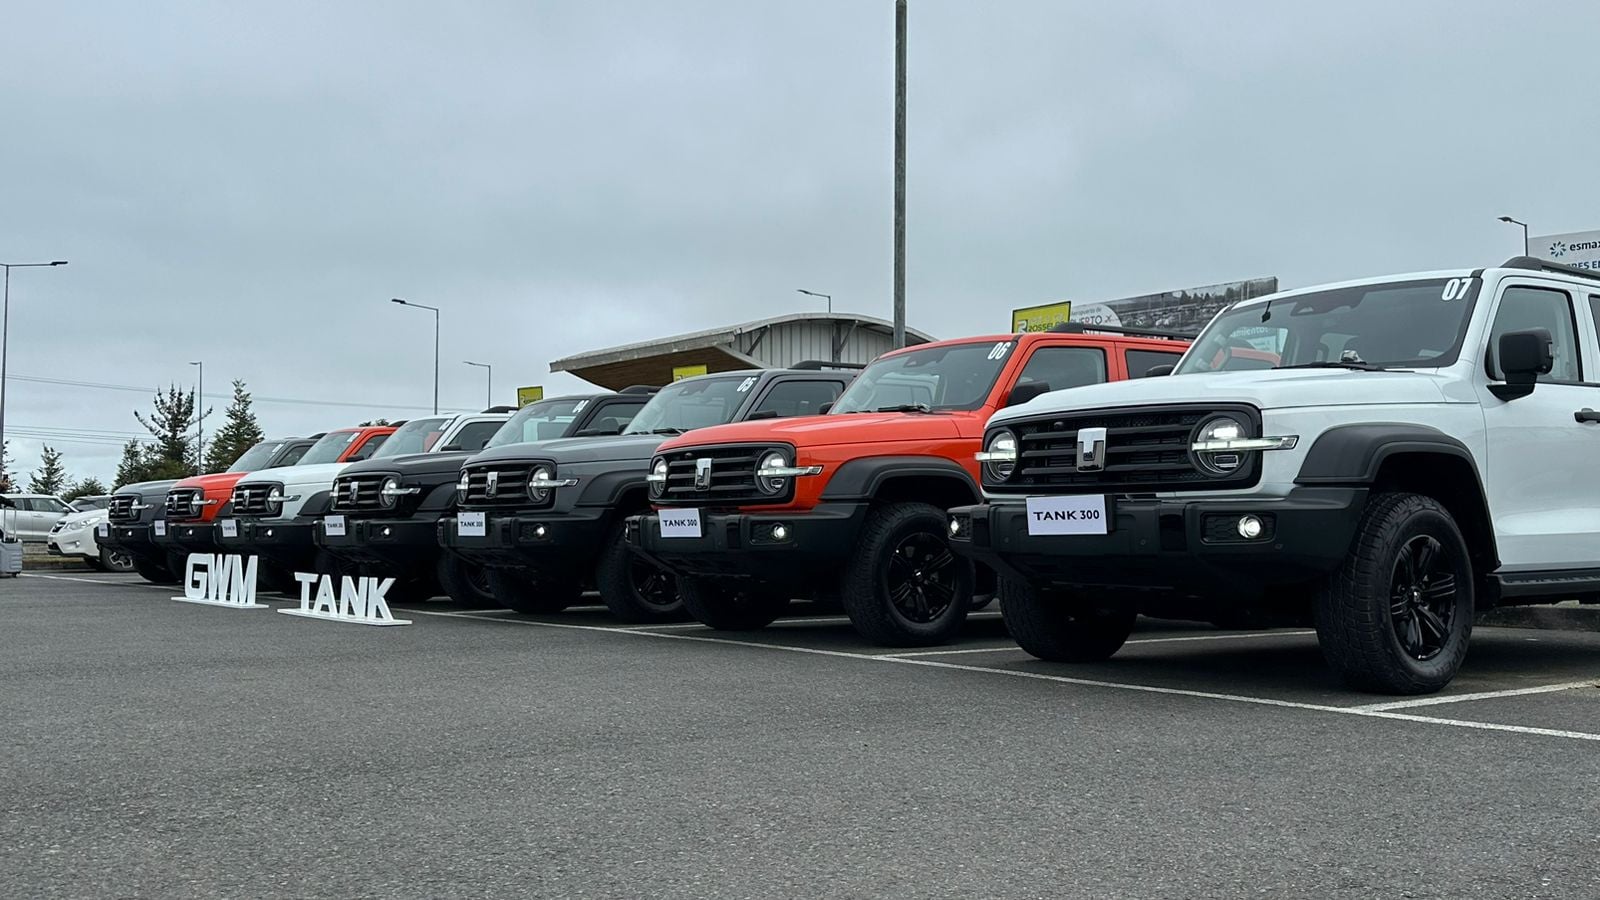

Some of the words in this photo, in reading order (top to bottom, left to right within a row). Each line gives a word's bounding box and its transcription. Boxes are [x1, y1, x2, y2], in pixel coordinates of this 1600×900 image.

[1567, 261, 1590, 270] RES
[1441, 277, 1474, 301] 07
[987, 341, 1012, 360] 06
[736, 376, 758, 392] 05
[662, 519, 686, 528] TANK
[686, 518, 698, 527] 300
[1033, 510, 1077, 521] TANK
[1079, 509, 1100, 520] 300
[184, 552, 258, 605] GWM
[294, 571, 397, 621] TANK
